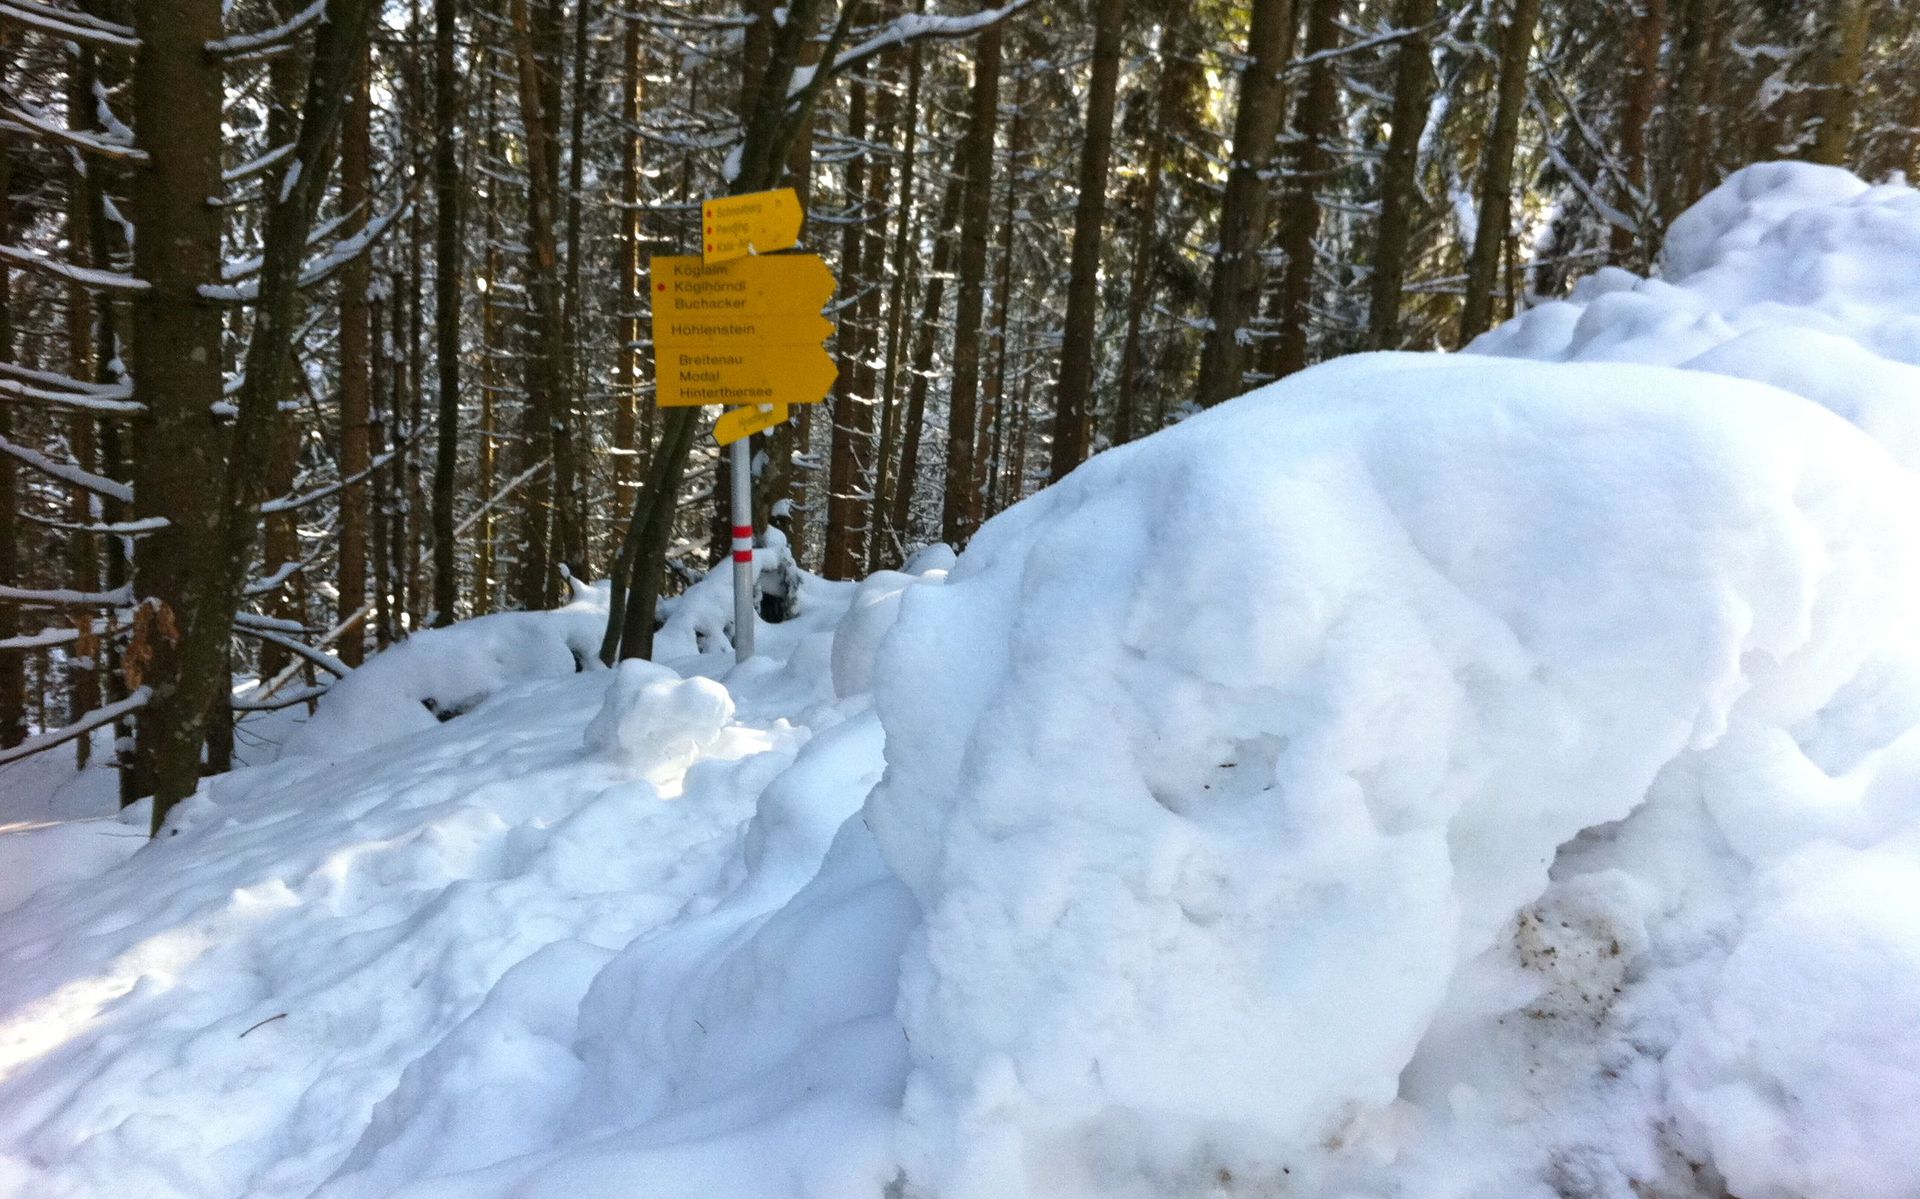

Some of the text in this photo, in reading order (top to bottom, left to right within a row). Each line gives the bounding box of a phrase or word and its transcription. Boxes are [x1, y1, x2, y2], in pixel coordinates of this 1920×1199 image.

[674, 297, 746, 310] Buchacker
[671, 323, 755, 336] Höhlenstein
[679, 353, 743, 366] Breitenau
[679, 370, 720, 382] Modal
[679, 386, 773, 398] Hinterthiersee
